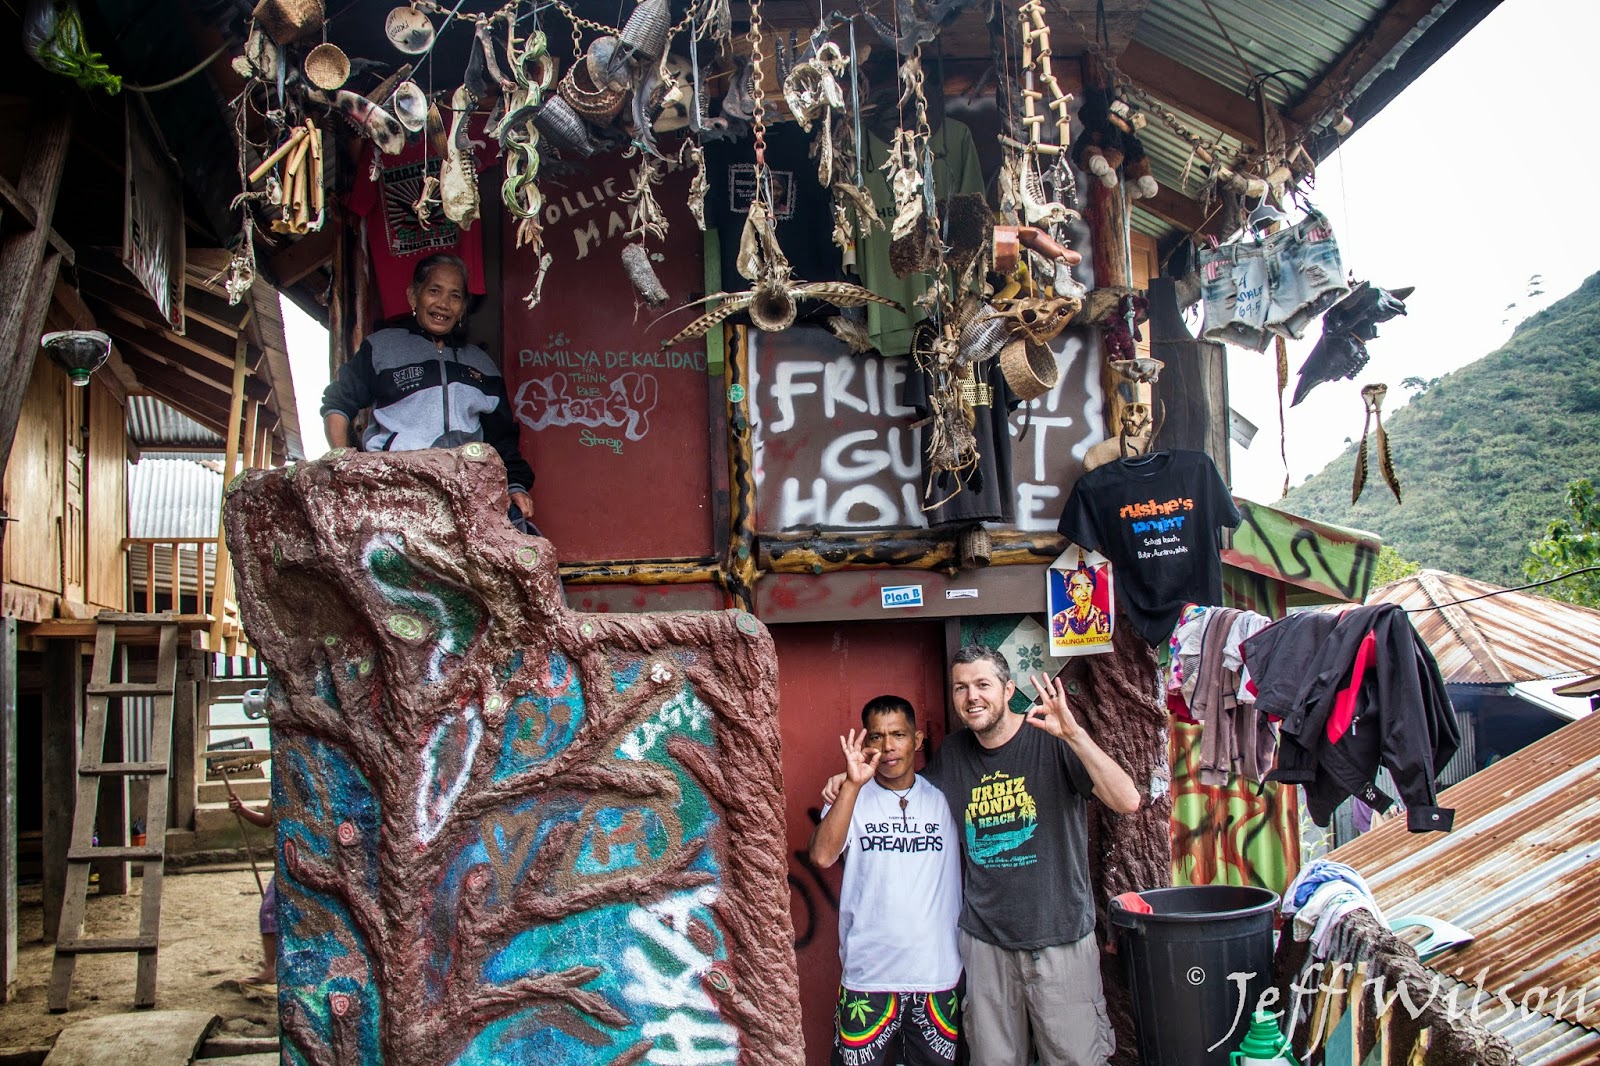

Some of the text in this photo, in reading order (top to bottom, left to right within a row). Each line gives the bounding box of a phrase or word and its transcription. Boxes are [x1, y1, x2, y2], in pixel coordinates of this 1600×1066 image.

[518, 350, 600, 369] PAMILYA
[884, 588, 920, 604] Plan B
[1085, 635, 1109, 643] TATTOO
[971, 776, 1026, 803] URBIZ
[968, 791, 1029, 818] TONDO
[864, 822, 940, 834] BUS FULL OF
[978, 811, 1016, 829] BEACH
[859, 835, 943, 853] DREAMERS
